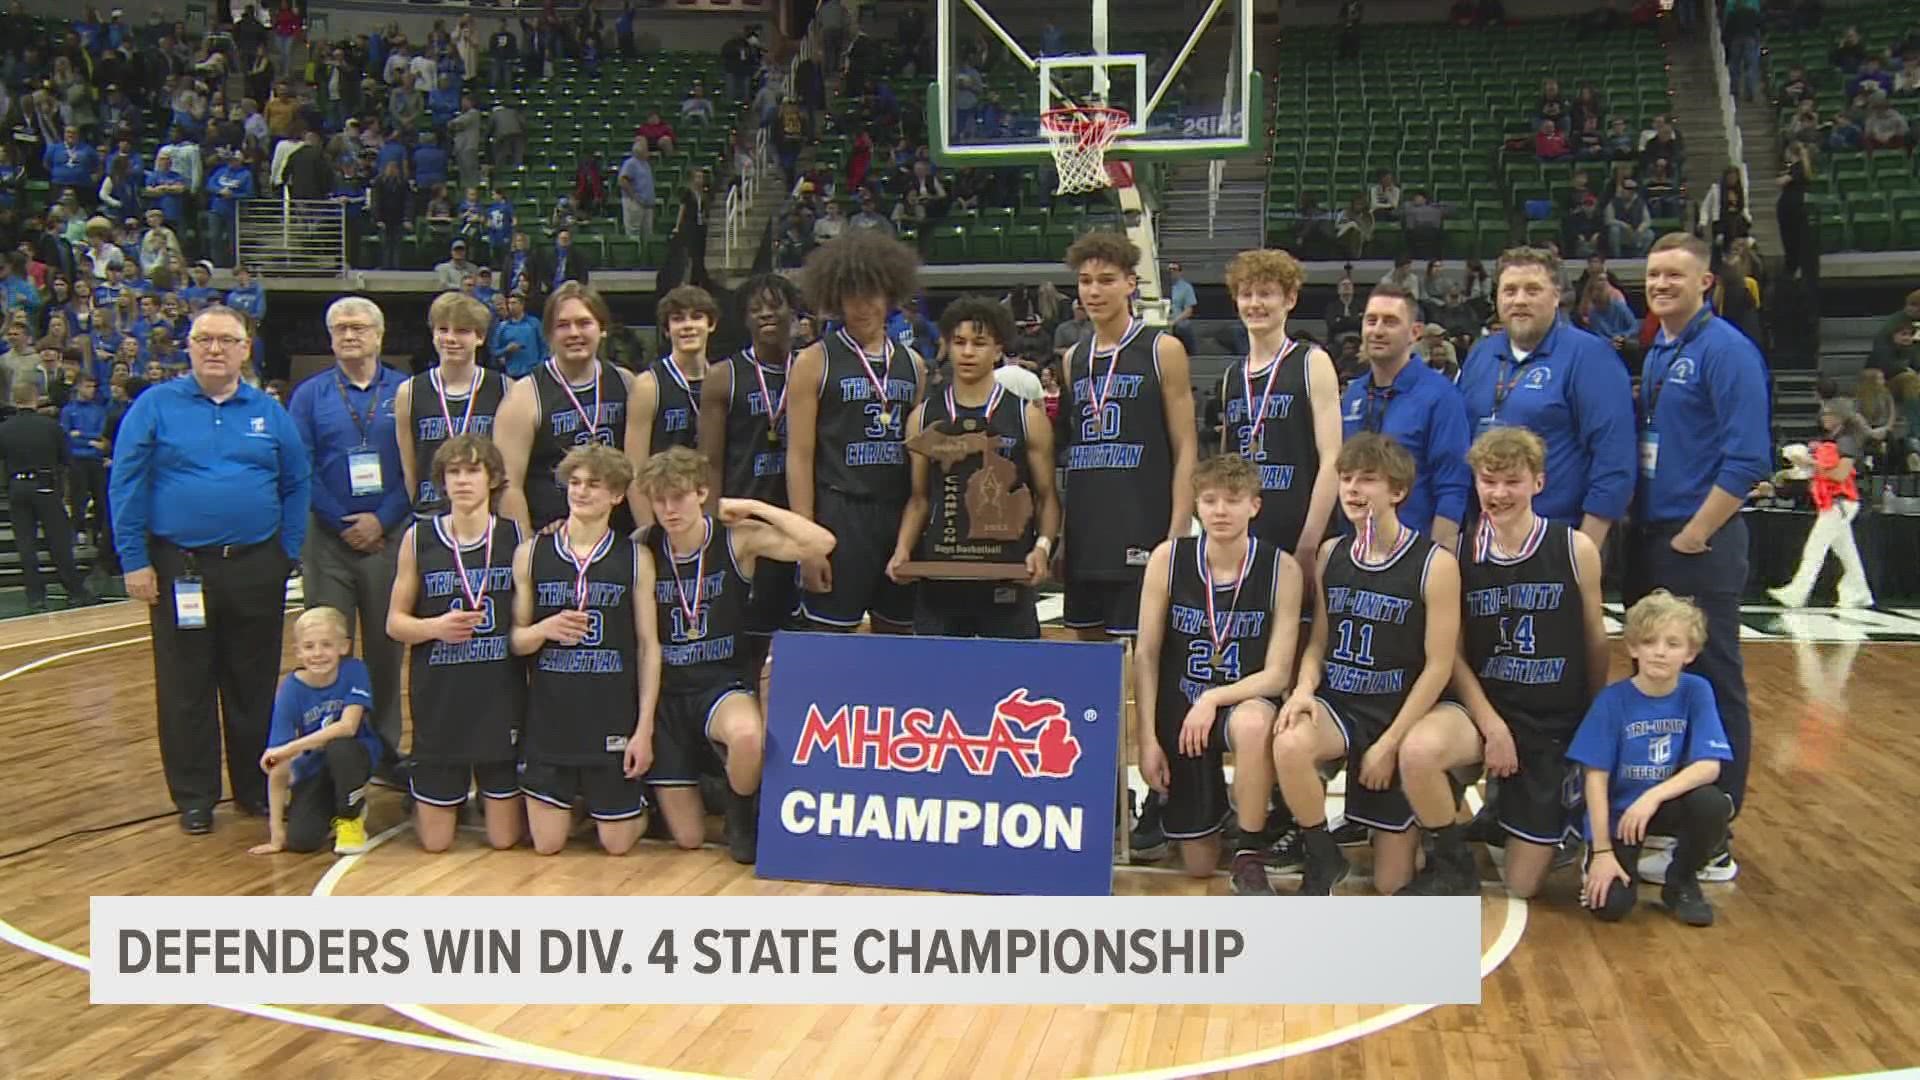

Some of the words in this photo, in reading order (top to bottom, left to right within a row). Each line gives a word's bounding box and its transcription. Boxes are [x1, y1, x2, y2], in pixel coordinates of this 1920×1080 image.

[864, 403, 903, 438] 34
[1082, 402, 1121, 441] 20
[1333, 619, 1374, 665] 11
[1494, 615, 1536, 654] 14
[1187, 639, 1240, 680] 24
[793, 702, 1040, 778] MHSAA
[780, 790, 1084, 852] CHAMPION
